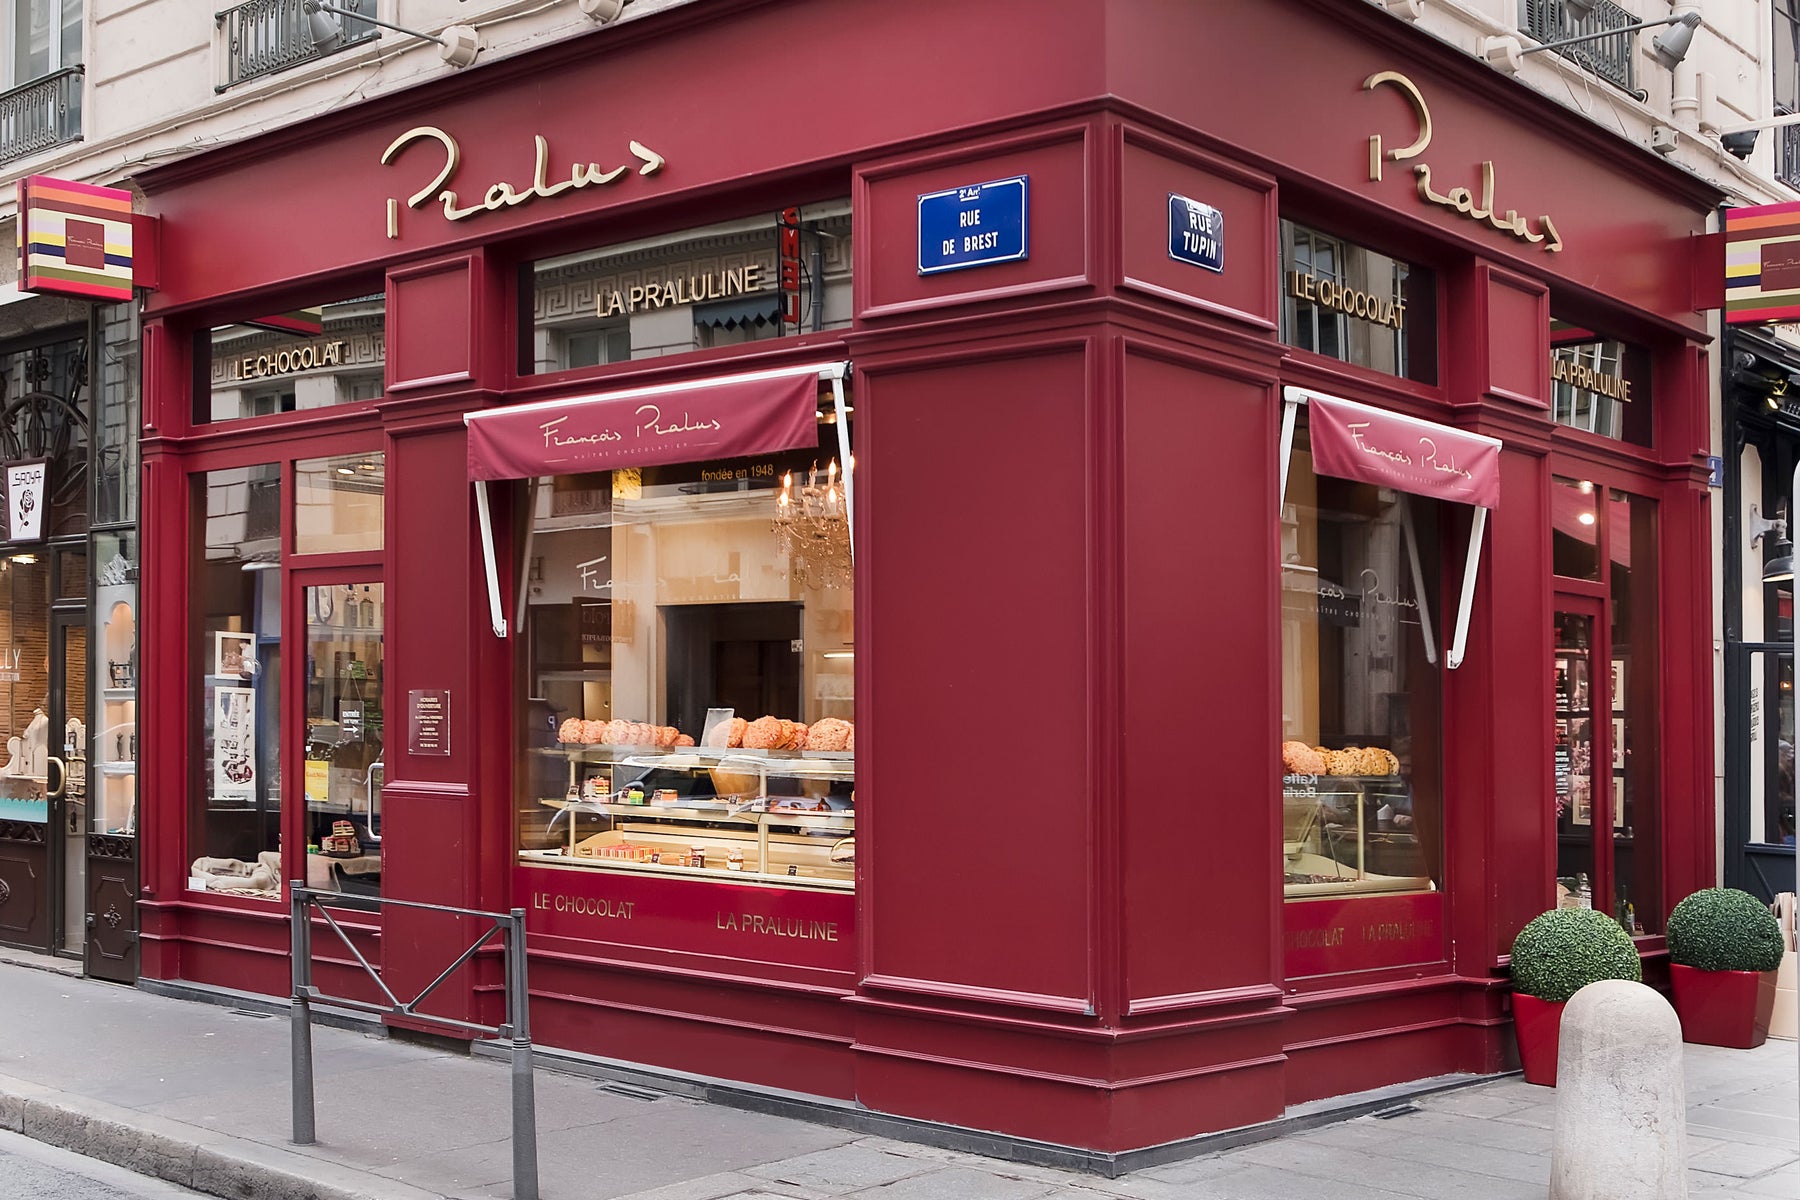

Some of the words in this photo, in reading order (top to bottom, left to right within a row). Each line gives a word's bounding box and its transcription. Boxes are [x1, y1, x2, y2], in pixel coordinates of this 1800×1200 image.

[1363, 70, 1563, 252] Pralus
[381, 126, 665, 239] Pralus
[960, 208, 981, 228] RUE
[1189, 212, 1212, 234] RUE
[942, 240, 955, 256] DE
[964, 232, 999, 252] BREST
[1183, 231, 1217, 261] TUPIN
[597, 293, 626, 318] LA
[630, 264, 762, 312] PRALULINE
[1295, 269, 1316, 301] LE
[1320, 279, 1406, 330] CHOCOLAT
[234, 358, 254, 380] LE
[256, 341, 345, 377] CHOCOLAT
[1552, 356, 1569, 382] LA
[1570, 362, 1632, 403] PRALULINE
[539, 415, 622, 448] François
[635, 404, 721, 438] Pralus
[1347, 422, 1412, 466] François
[1419, 437, 1473, 480] Pralus
[701, 467, 733, 481] fondée
[735, 469, 747, 479] en
[751, 463, 774, 477] 1948
[534, 892, 551, 910] LE
[555, 894, 635, 920] CHOCOLAT
[717, 911, 738, 931] LA
[742, 913, 839, 942] PRALULINE
